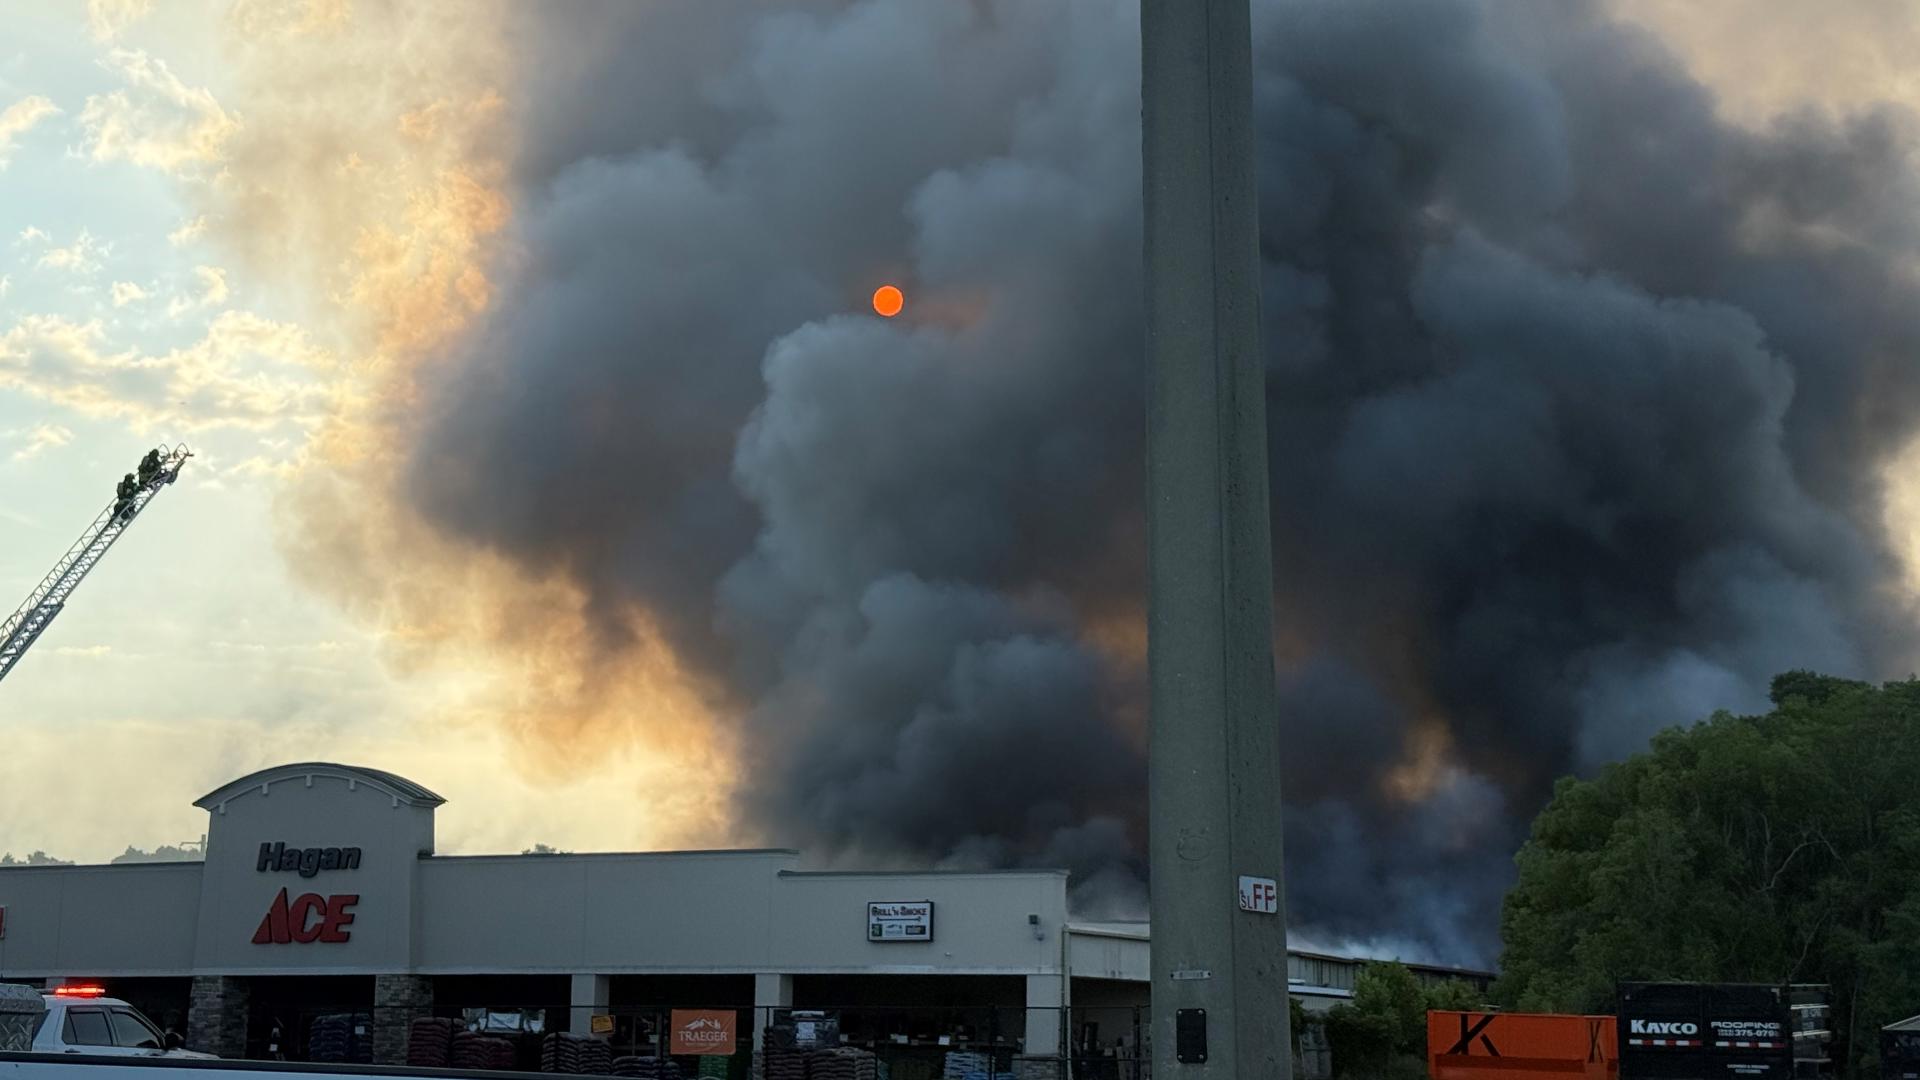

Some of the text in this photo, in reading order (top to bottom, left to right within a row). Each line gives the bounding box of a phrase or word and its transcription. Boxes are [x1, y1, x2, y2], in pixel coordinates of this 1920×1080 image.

[256, 841, 361, 878] Hagan
[1253, 884, 1275, 911] FF
[251, 886, 360, 944] ACE
[678, 1030, 729, 1042] TRAEGER
[1630, 1019, 1698, 1035] KAYCO
[1710, 1021, 1781, 1030] ROOFING
